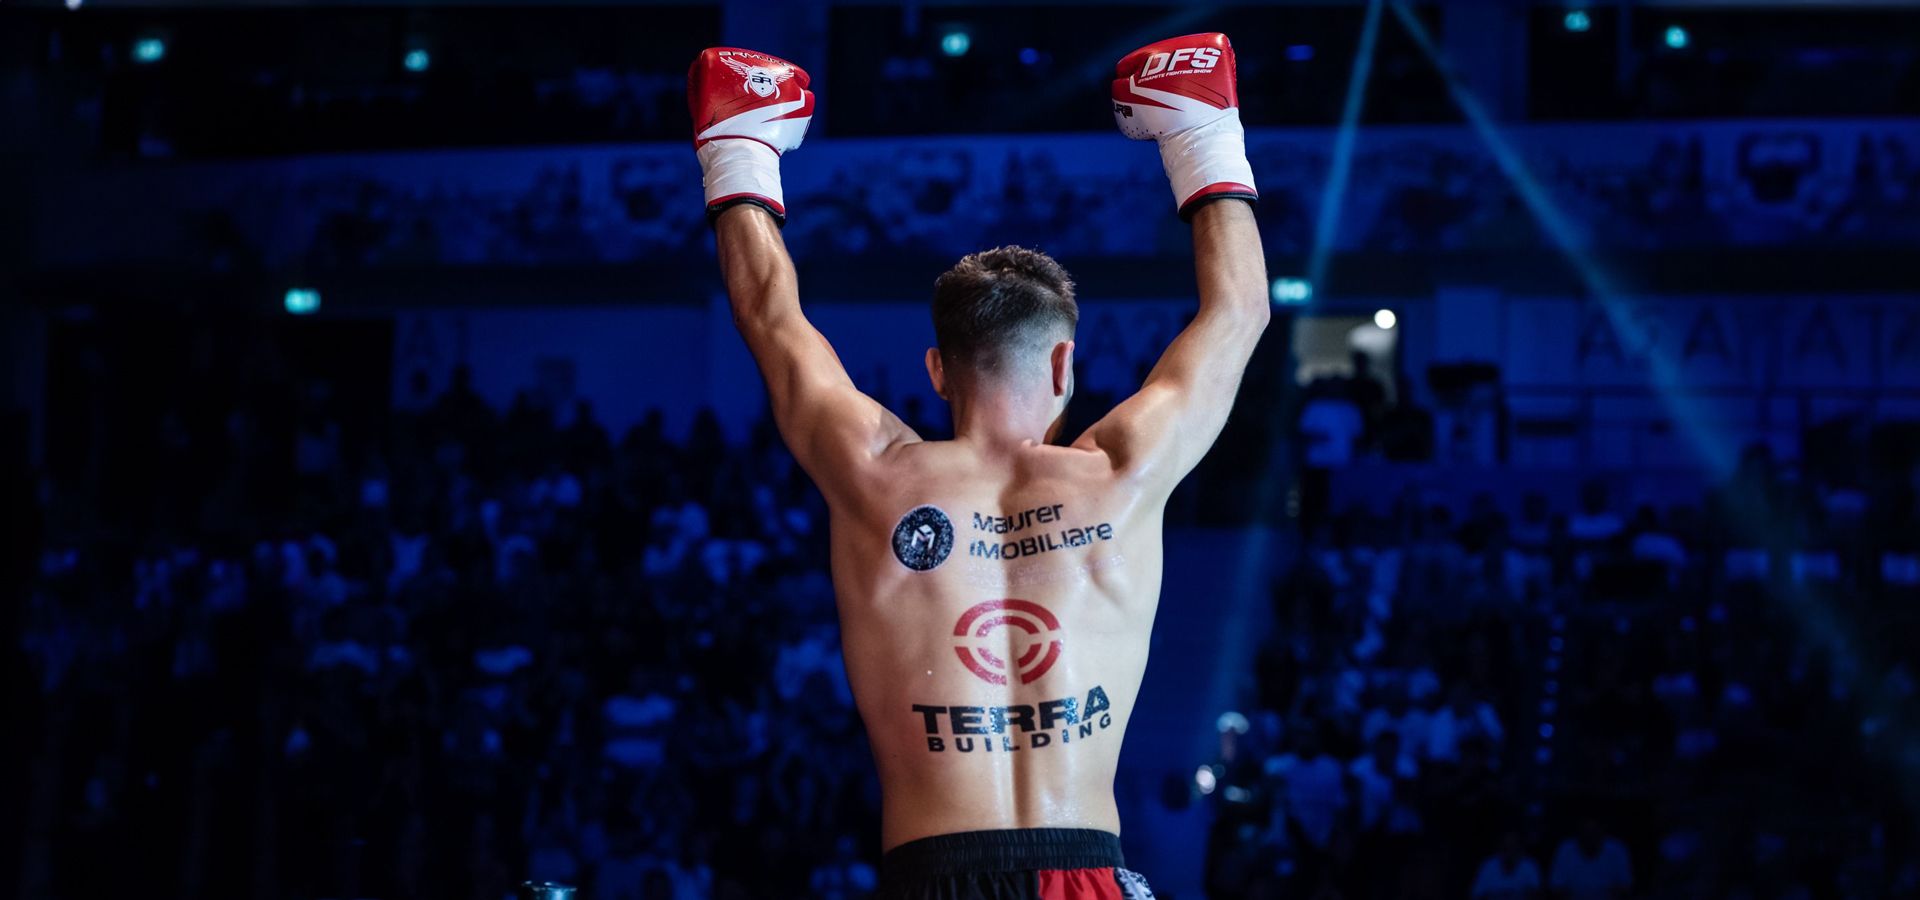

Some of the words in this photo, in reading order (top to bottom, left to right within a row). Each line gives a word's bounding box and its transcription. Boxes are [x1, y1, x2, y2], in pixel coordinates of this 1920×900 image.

[1141, 47, 1222, 78] DFS
[912, 685, 1110, 735] TERRA
[928, 714, 1111, 752] BUILDING
